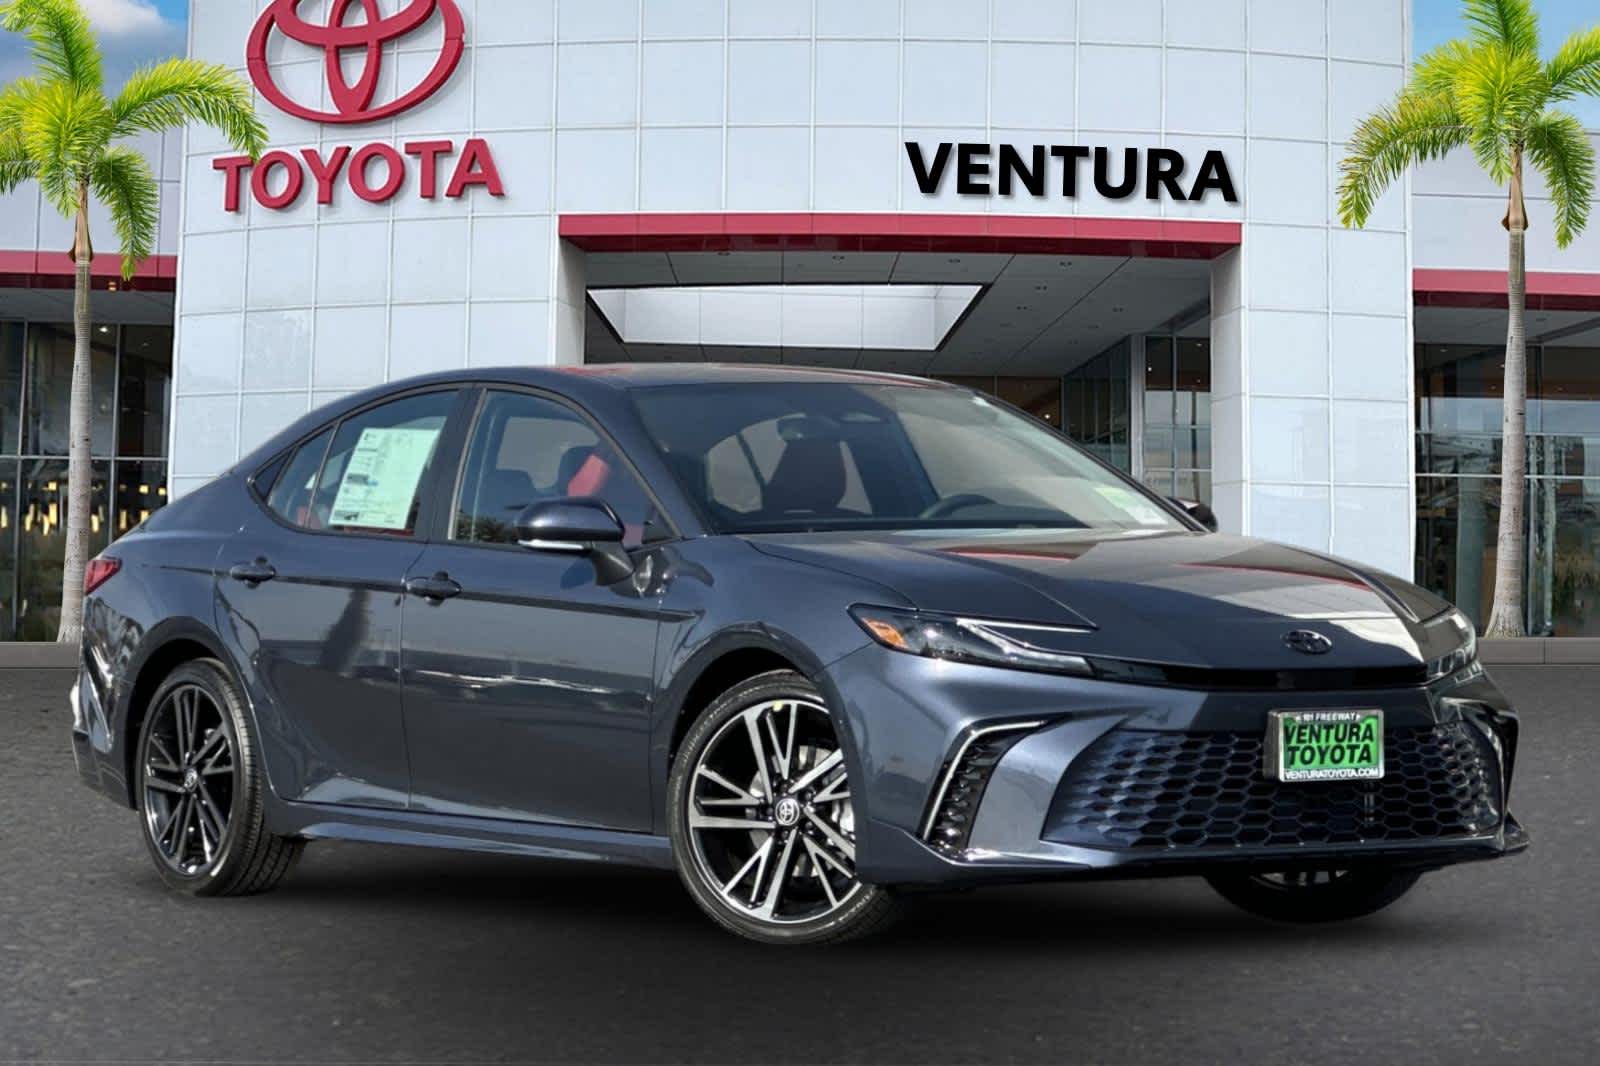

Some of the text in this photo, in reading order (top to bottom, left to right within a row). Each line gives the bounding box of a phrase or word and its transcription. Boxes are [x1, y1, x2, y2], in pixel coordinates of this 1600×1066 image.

[213, 138, 505, 212] TOYOTA
[904, 142, 1239, 203] VENTURA
[1283, 723, 1374, 744] VENTURA
[1287, 744, 1372, 765] TOYOTA
